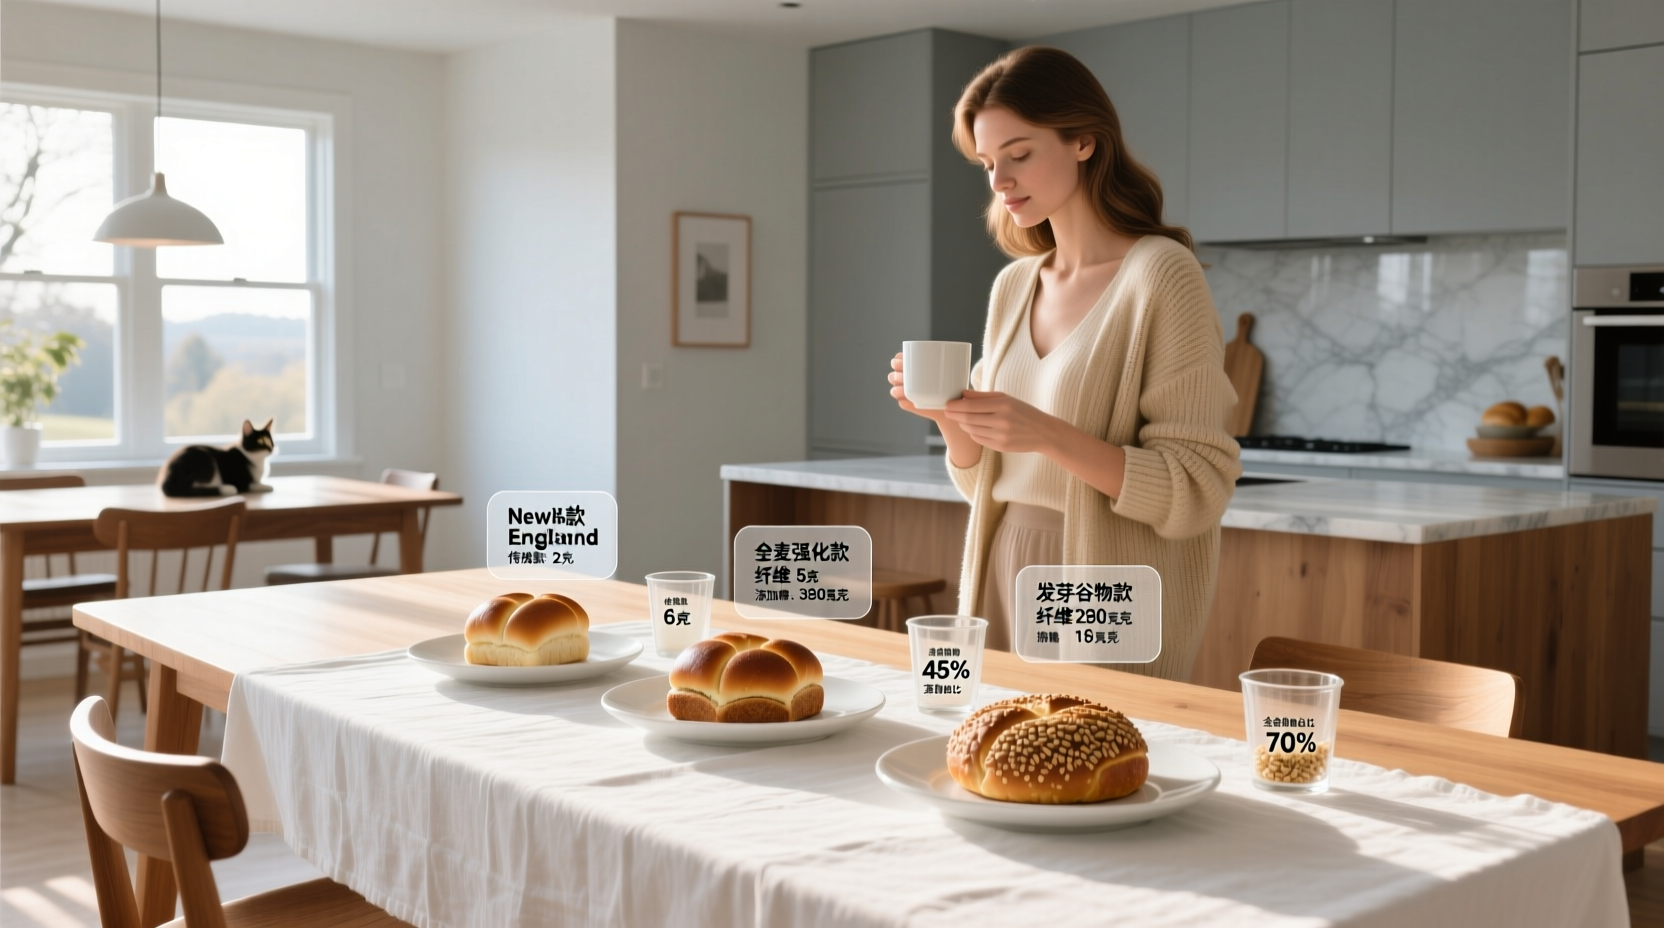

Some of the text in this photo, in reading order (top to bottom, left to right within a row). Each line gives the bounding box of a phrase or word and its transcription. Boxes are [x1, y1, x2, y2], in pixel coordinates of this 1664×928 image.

[664, 608, 691, 626] 6克
[922, 660, 970, 679] 45%
[1266, 732, 1316, 753] 70%
